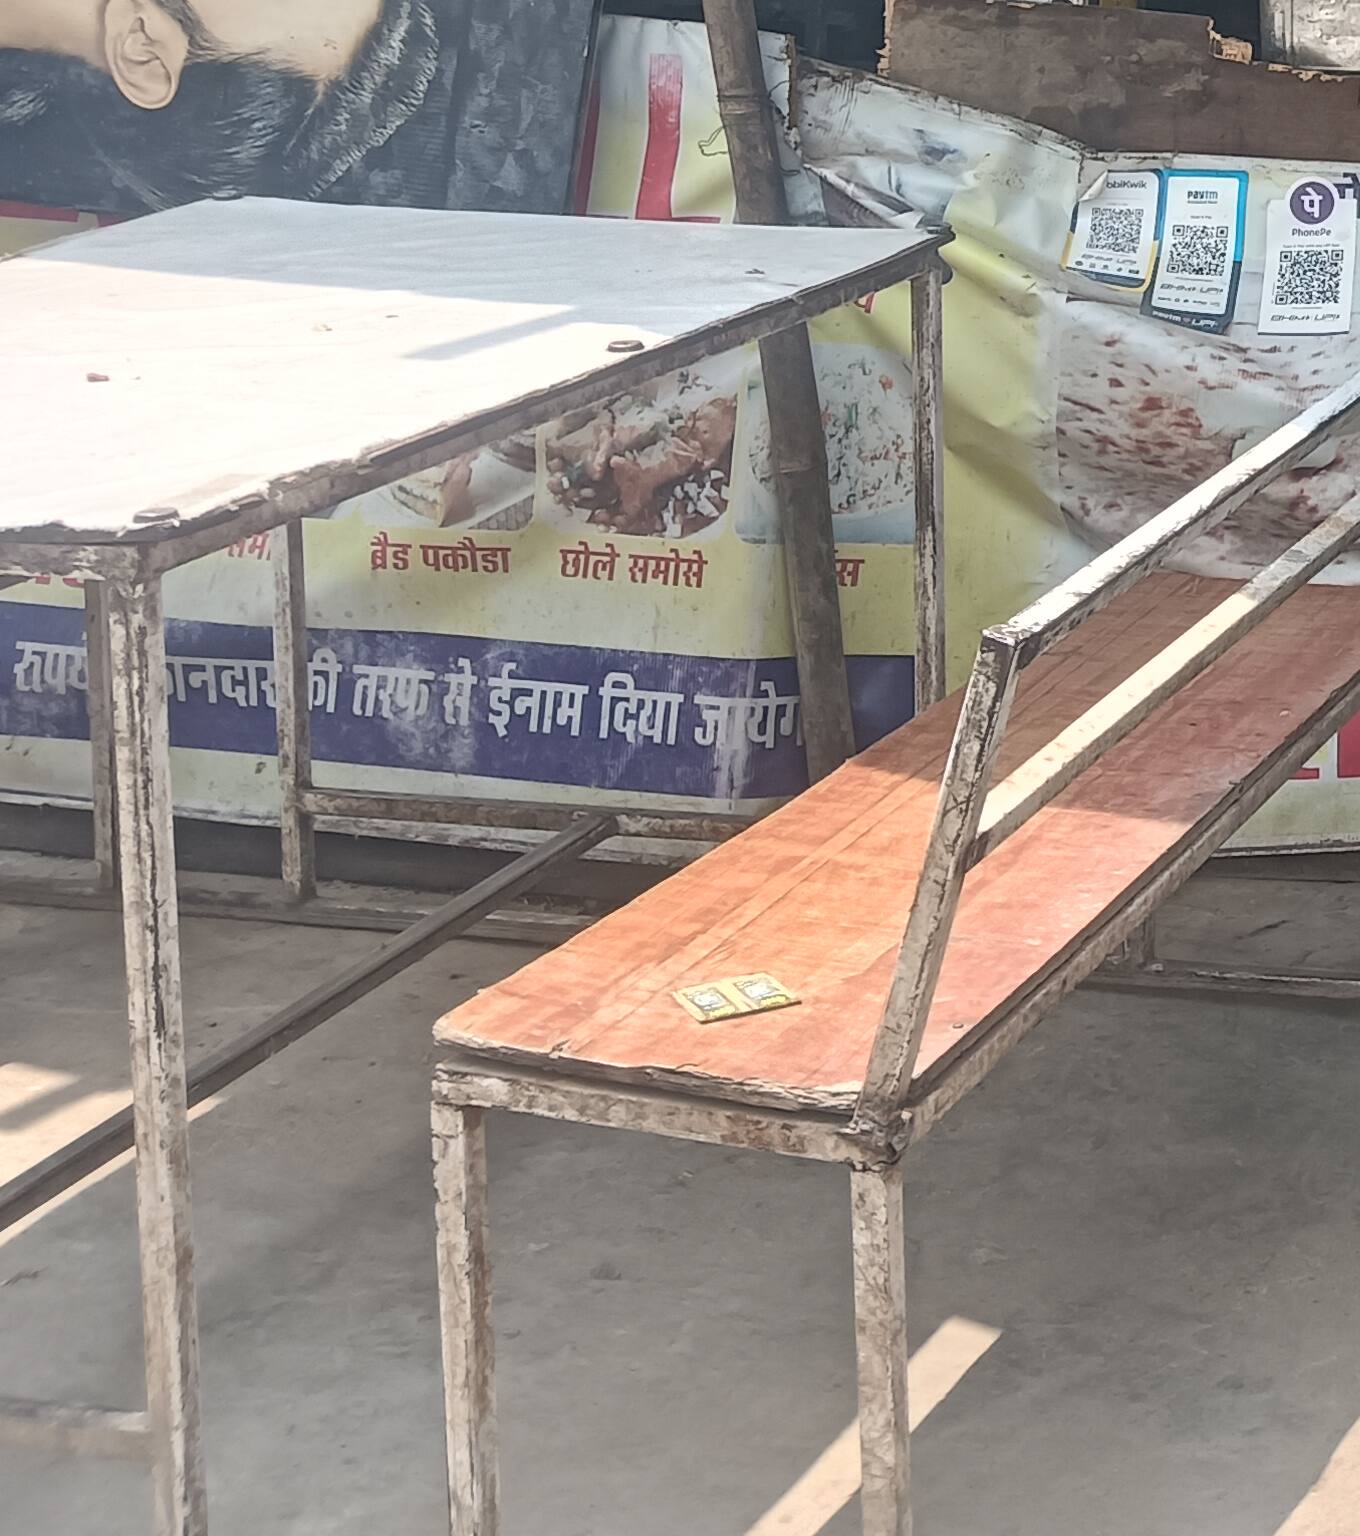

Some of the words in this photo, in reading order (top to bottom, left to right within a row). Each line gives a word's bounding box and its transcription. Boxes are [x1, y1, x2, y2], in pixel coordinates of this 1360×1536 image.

[1106, 179, 1147, 190] obiKwik
[1186, 189, 1219, 201] paytm
[1291, 226, 1332, 238] PhonePe
[421, 541, 513, 575] पकौडा
[560, 542, 621, 585] छोले
[627, 547, 709, 589] समोसे
[166, 654, 277, 709] ानदार
[352, 656, 436, 720] तरफ
[442, 656, 478, 728] से
[486, 658, 591, 737] ईनाम
[599, 672, 681, 747] दिया
[693, 679, 801, 749] जायेग
